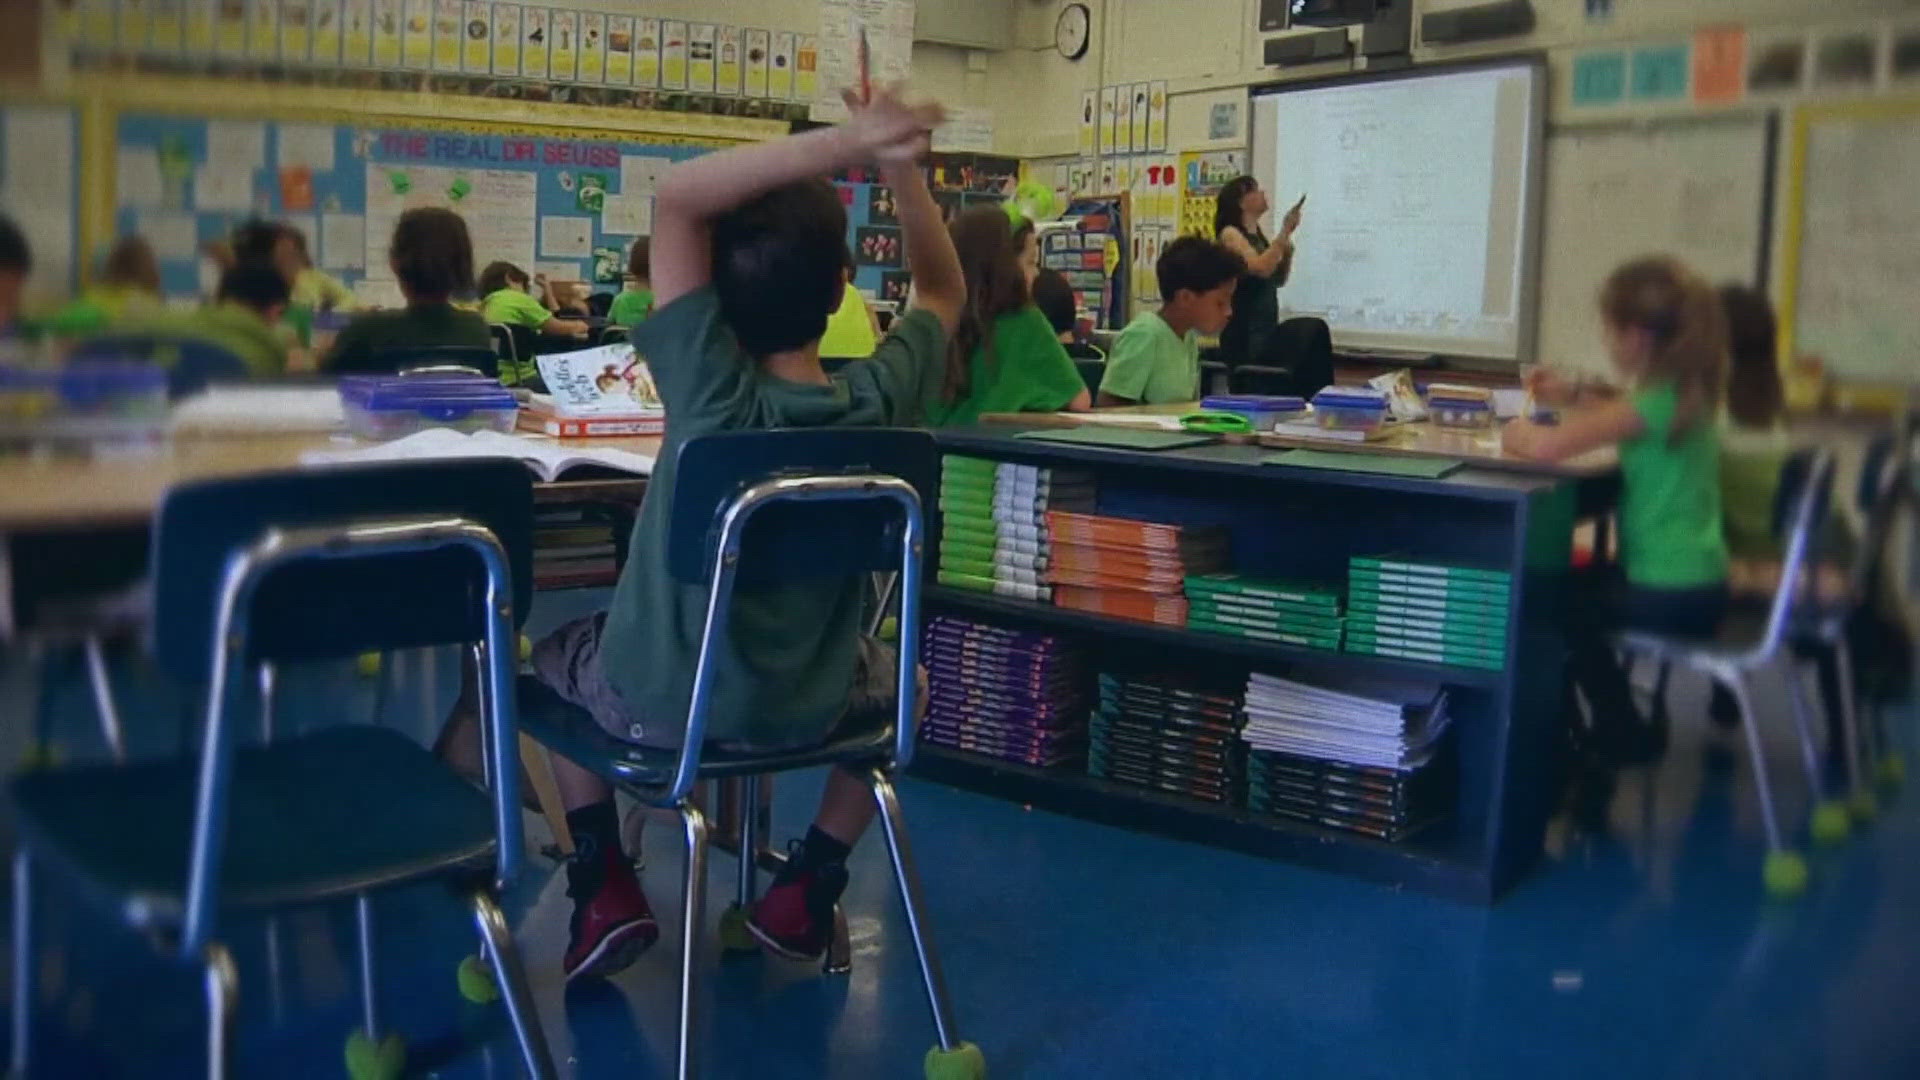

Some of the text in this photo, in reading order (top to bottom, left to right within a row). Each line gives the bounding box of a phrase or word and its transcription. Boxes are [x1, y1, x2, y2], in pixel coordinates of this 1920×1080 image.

[382, 134, 428, 158] THE
[434, 137, 499, 161] REAL
[543, 143, 619, 168] SEUSS
